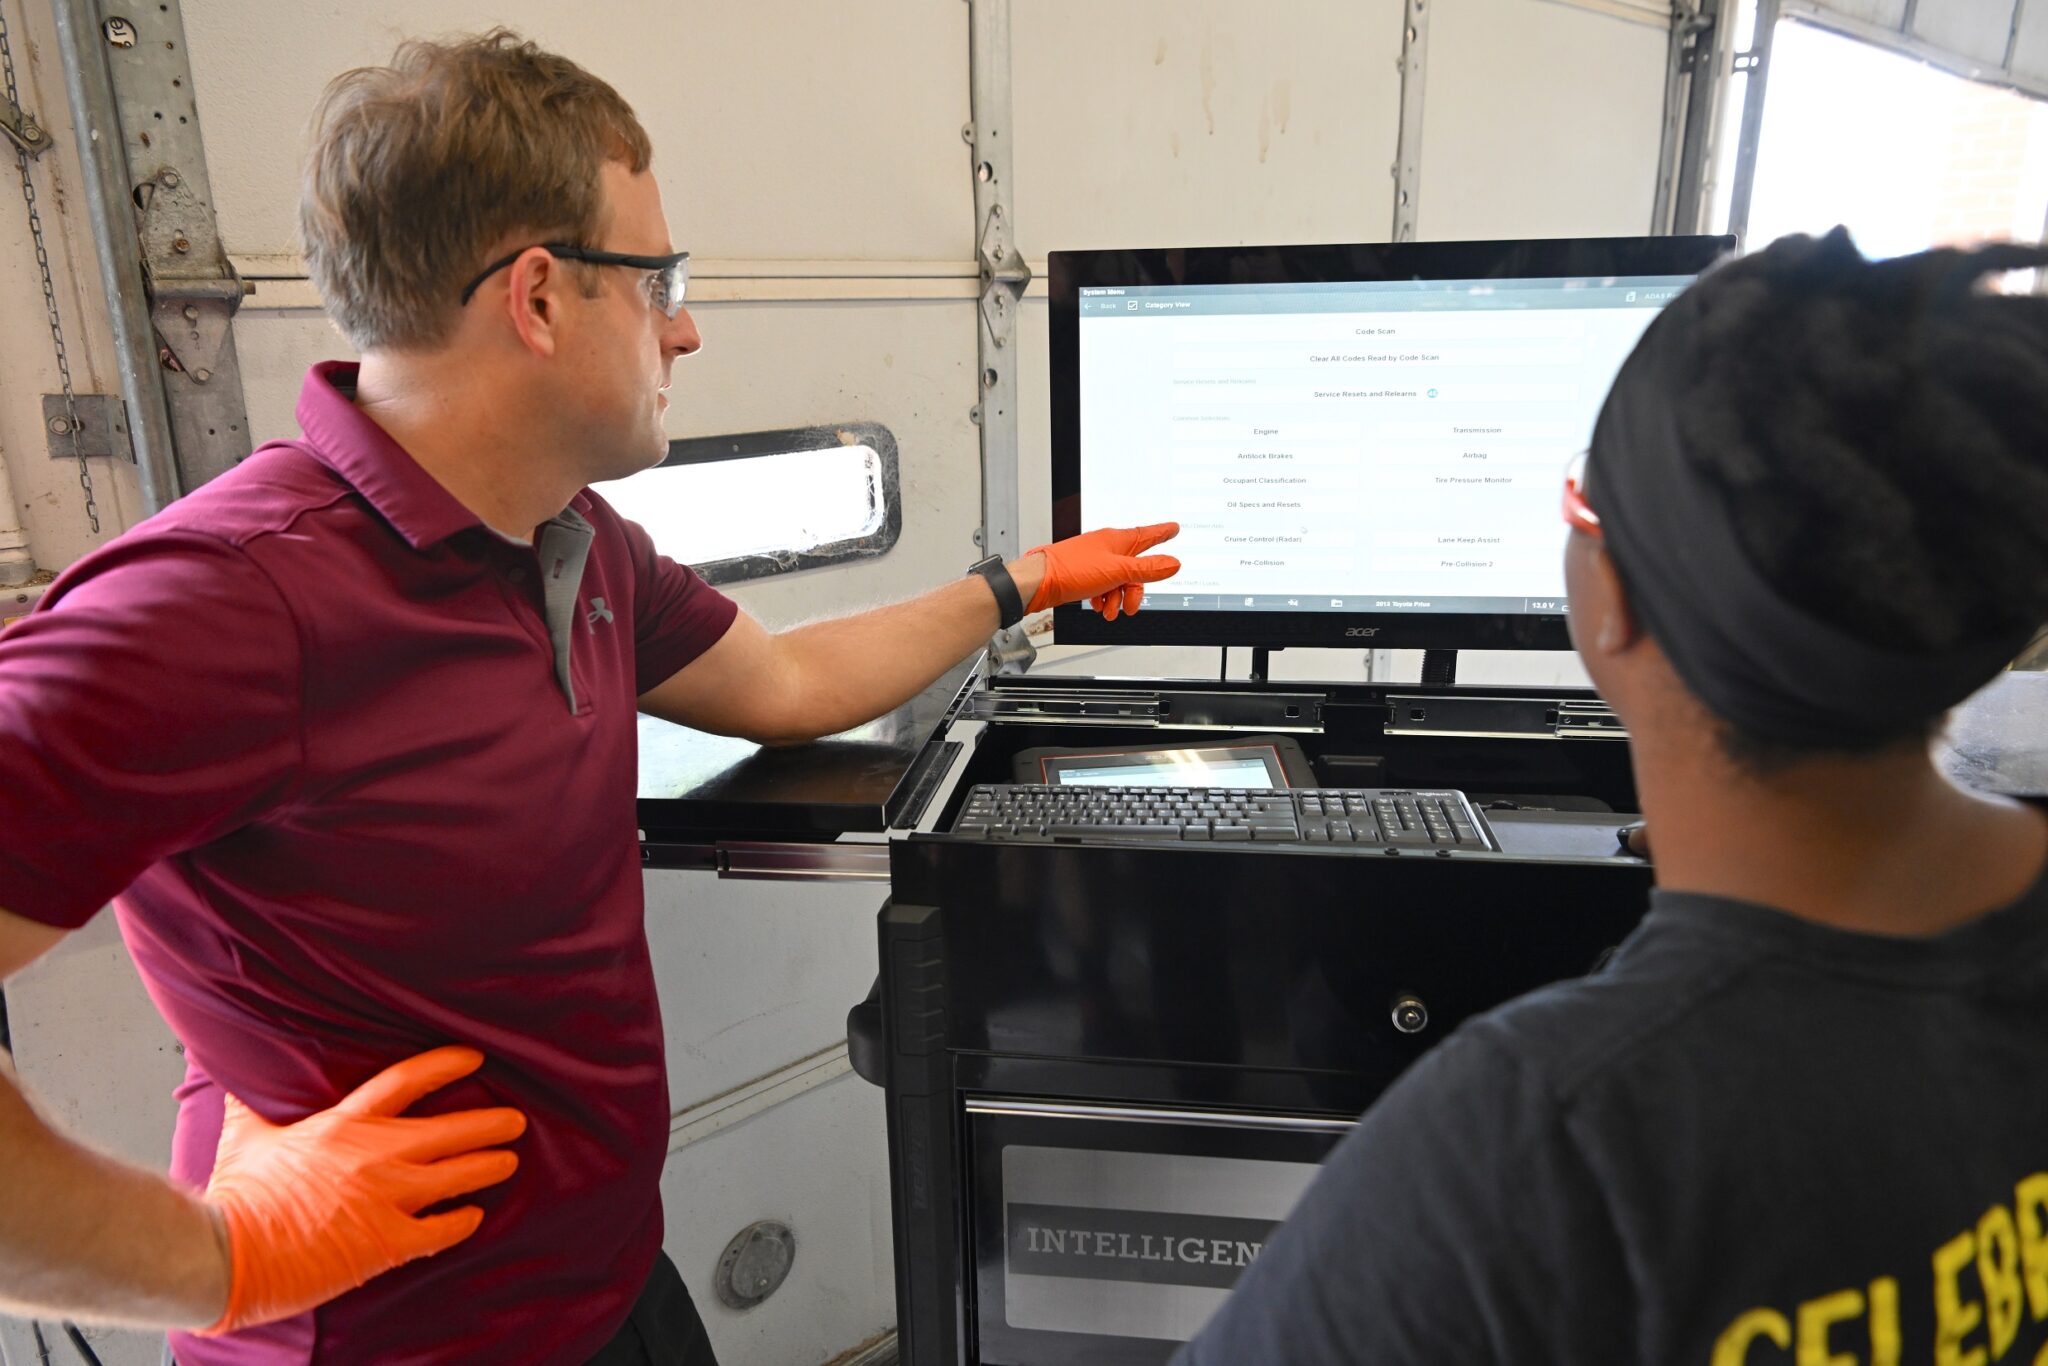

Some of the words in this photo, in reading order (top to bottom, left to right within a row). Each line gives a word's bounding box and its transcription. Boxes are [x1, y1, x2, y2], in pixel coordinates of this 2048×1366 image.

[1082, 289, 1106, 297] System
[1106, 288, 1125, 296] Menu
[1388, 355, 1397, 363] by
[1253, 428, 1279, 436] Engine
[1452, 426, 1502, 434] Transmission
[1462, 452, 1488, 460] Airbag
[1222, 477, 1257, 485] Occupant
[1258, 477, 1307, 485] Classification
[1238, 501, 1261, 509] Specs
[1275, 535, 1302, 544] (Radar)
[1437, 536, 1455, 544] Lane
[1456, 536, 1476, 545] Keep
[1476, 536, 1500, 544] Assist
[1239, 558, 1285, 567] Pre-Collision
[1440, 560, 1487, 568] Pre-Collision
[1488, 560, 1494, 568] 2
[1391, 601, 1413, 609] Toyota
[1345, 627, 1380, 637] acer
[1027, 1226, 1263, 1267] INTELLIGEN
